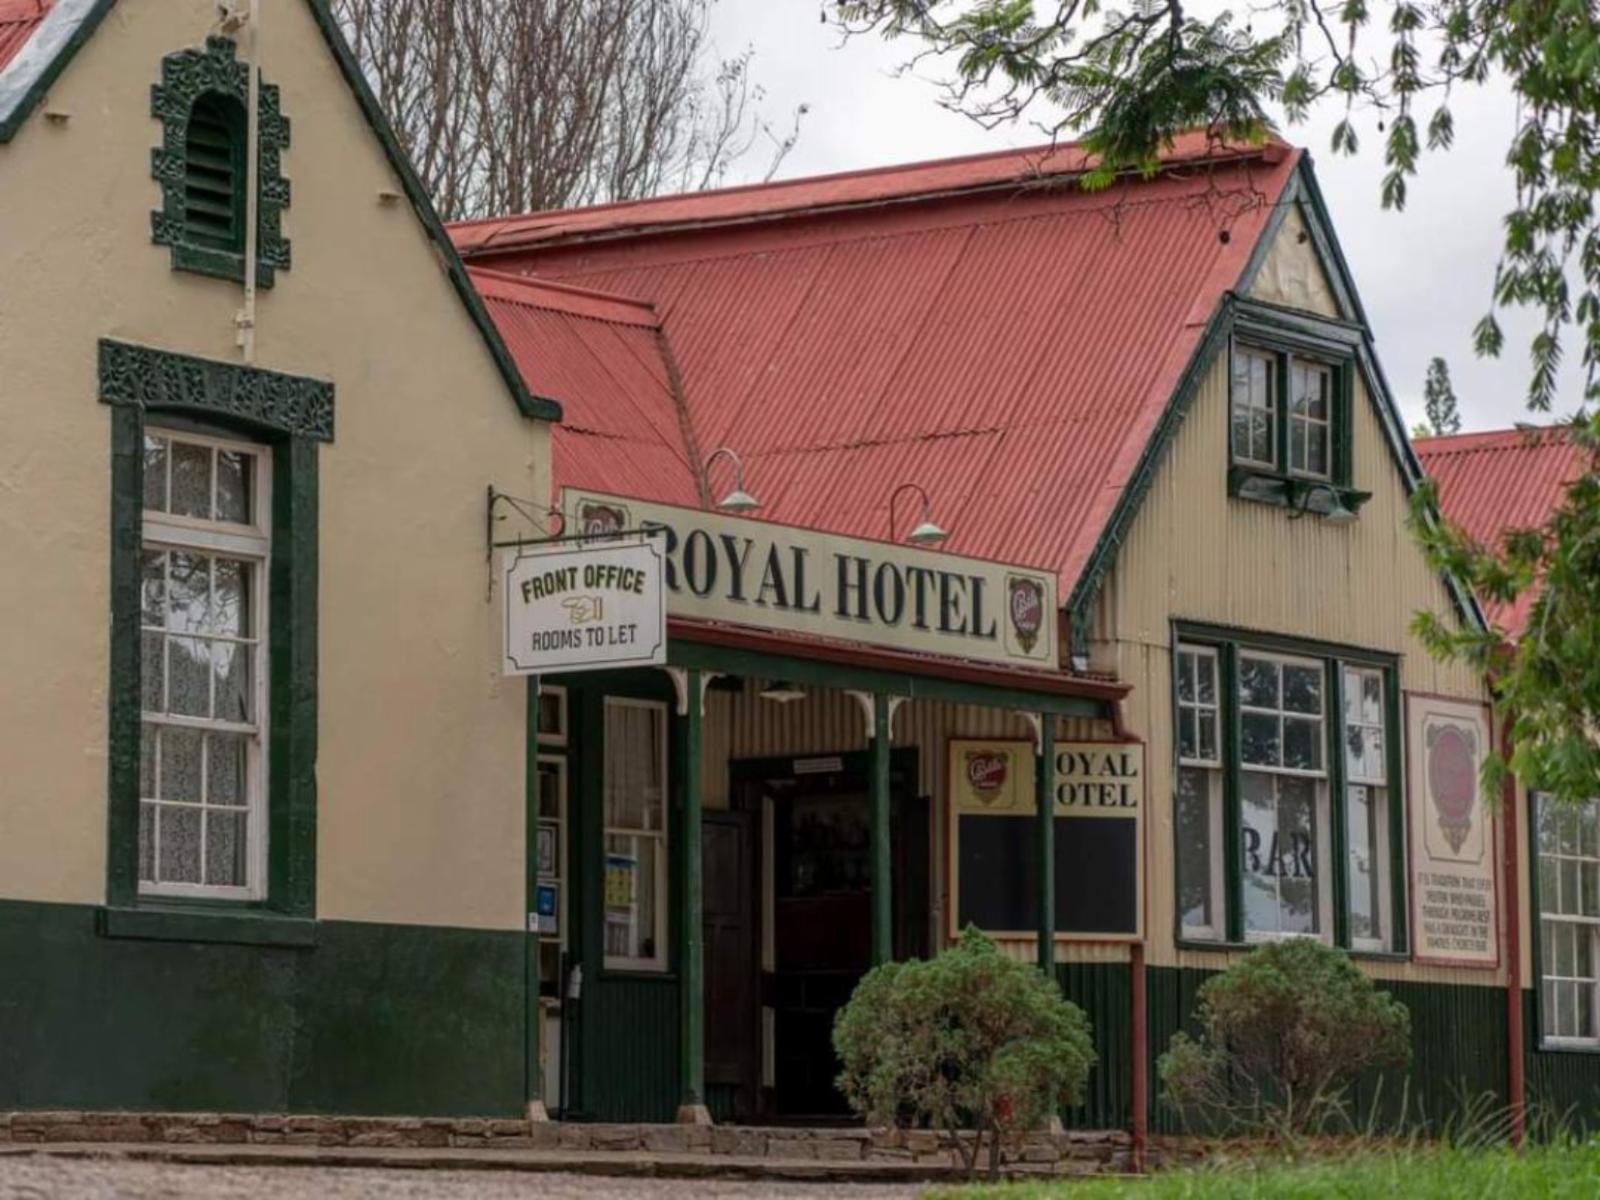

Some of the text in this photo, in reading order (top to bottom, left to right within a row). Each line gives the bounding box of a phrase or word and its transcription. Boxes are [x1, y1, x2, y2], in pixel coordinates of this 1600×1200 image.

[521, 564, 646, 604] FRONT OFFICE
[643, 520, 997, 640] ROYAL HOTEL
[532, 624, 637, 651] ROOMS TO LET
[1055, 752, 1138, 777] OYAL
[1055, 783, 1138, 808] OTEL
[1240, 827, 1313, 878] BAR
